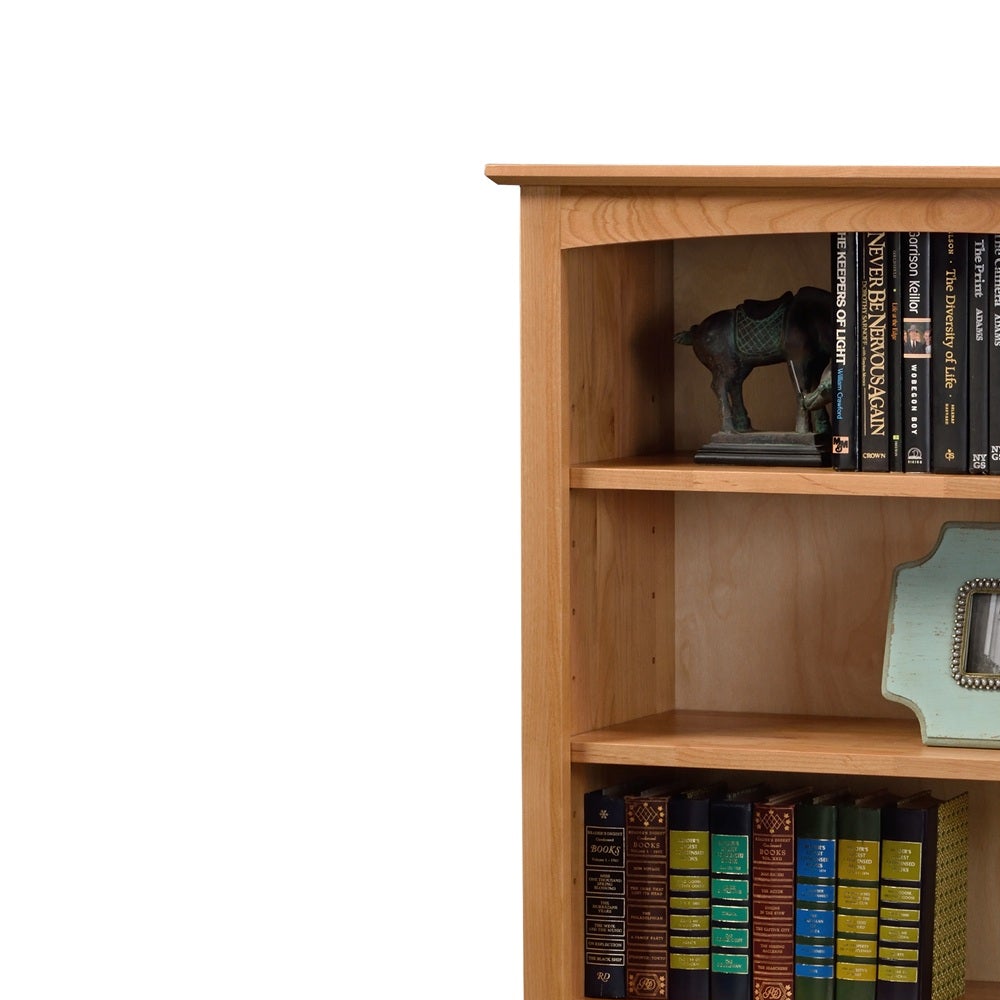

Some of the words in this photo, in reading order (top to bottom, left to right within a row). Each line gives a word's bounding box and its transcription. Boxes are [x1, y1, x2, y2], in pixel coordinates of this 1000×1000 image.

[836, 231, 847, 249] HE
[974, 239, 986, 263] The
[867, 231, 886, 288] NEVER
[836, 252, 847, 308] KEEPERS
[945, 268, 957, 292] The
[974, 264, 986, 299] Print
[908, 280, 921, 314] Keillor
[836, 309, 847, 328] OF
[942, 295, 957, 348] Diversity
[975, 308, 984, 341] ADAMS
[835, 328, 847, 365] LIGHT
[868, 313, 887, 385] NERVOUS
[945, 351, 957, 364] of
[945, 366, 957, 389] Life
[836, 391, 844, 420] Crawford
[868, 384, 887, 436] AGAIN
[972, 453, 988, 462] NY
[972, 461, 987, 470] GS
[590, 844, 621, 856] BOOKS
